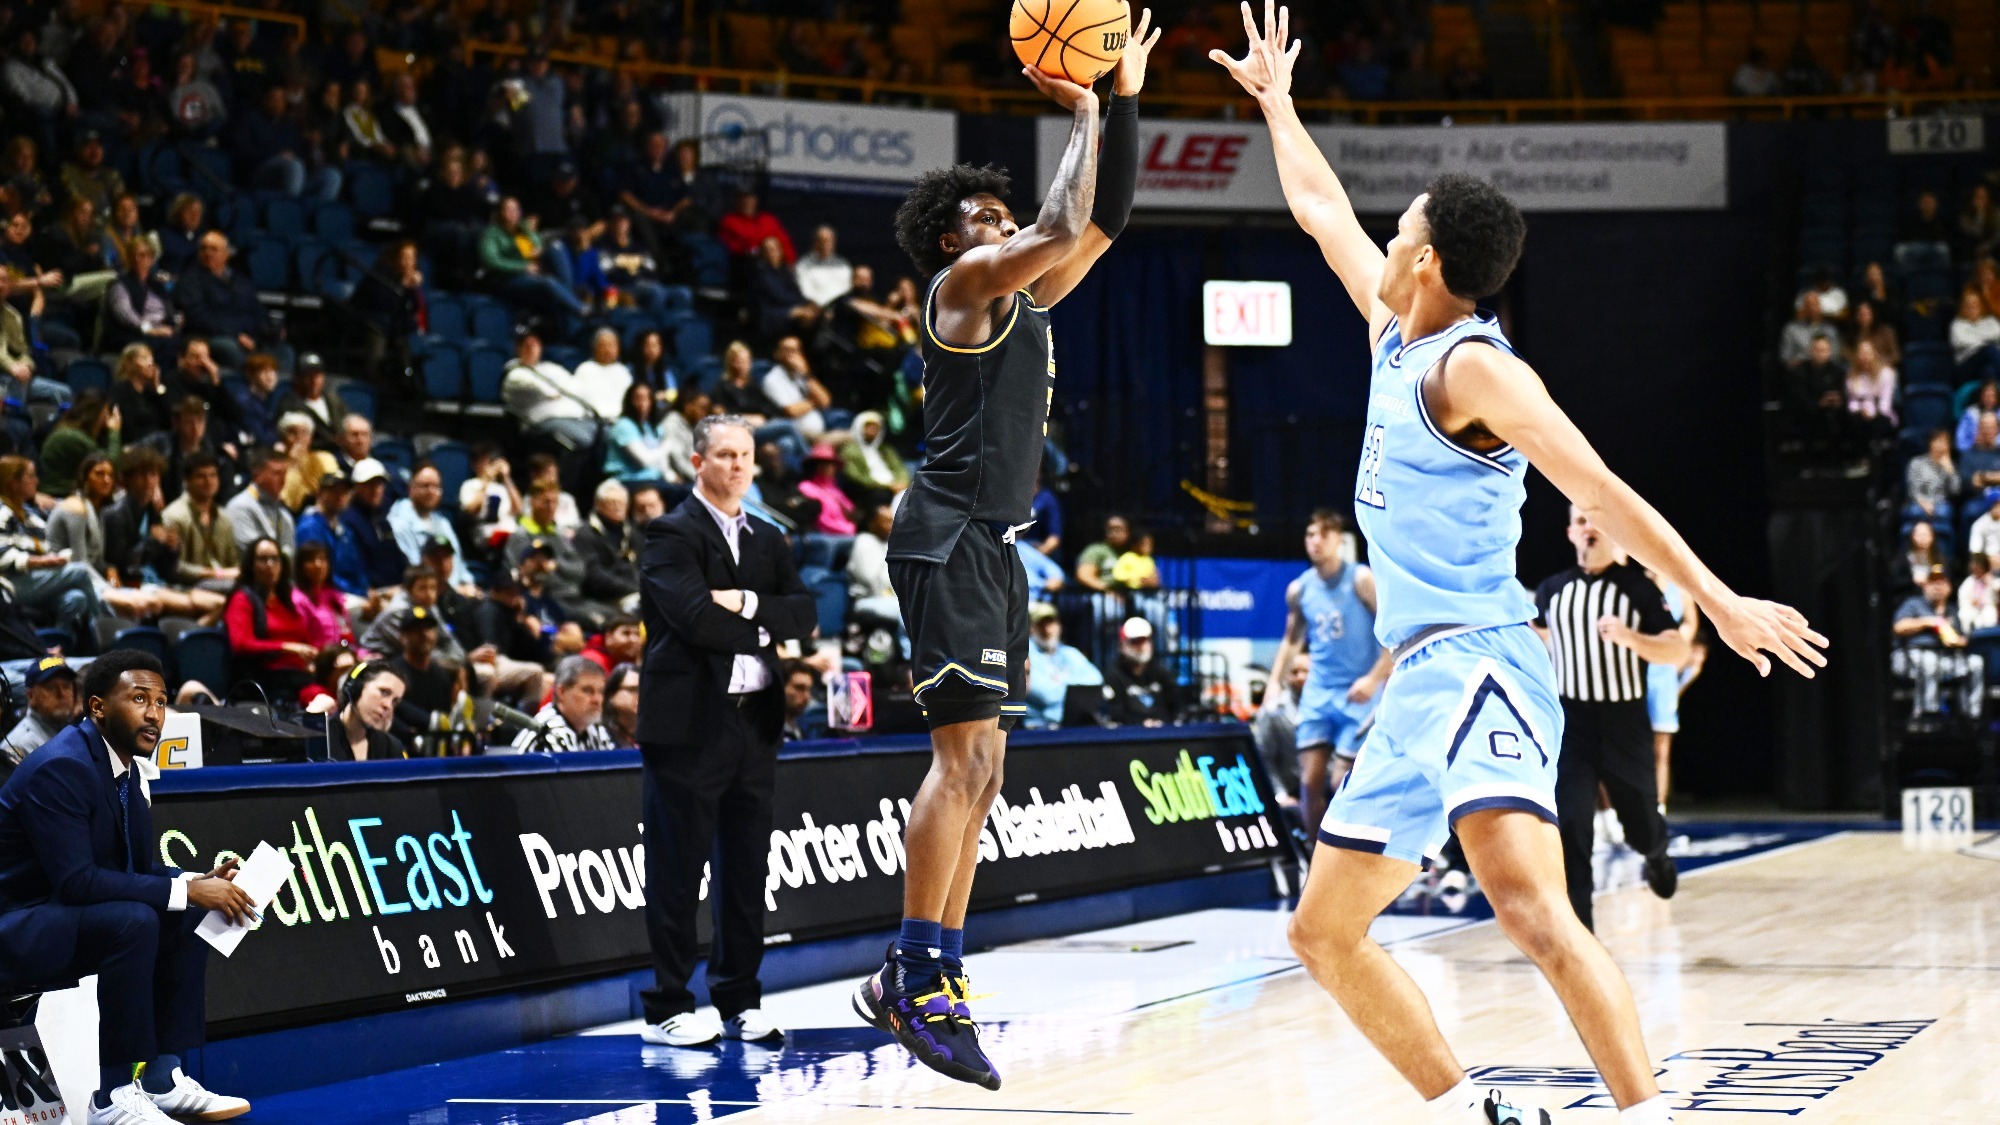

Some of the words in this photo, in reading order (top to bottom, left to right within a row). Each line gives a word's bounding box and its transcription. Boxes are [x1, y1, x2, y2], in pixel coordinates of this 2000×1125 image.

[763, 112, 915, 166] choices
[1144, 132, 1249, 174] LEE
[1339, 138, 1441, 168] Heating
[1466, 139, 1503, 162] Air
[1510, 137, 1689, 167] Conditioning
[1490, 167, 1611, 193] Electrical
[1213, 290, 1279, 336] EXIT
[1488, 730, 1522, 761] C
[1129, 748, 1265, 825] SouthEast
[866, 797, 908, 877] of
[988, 780, 1136, 859] Basketball
[1215, 815, 1279, 853] bank
[372, 911, 516, 975] bank
[405, 988, 447, 1003] DAKTRONICS
[24, 1106, 66, 1125] GROUP
